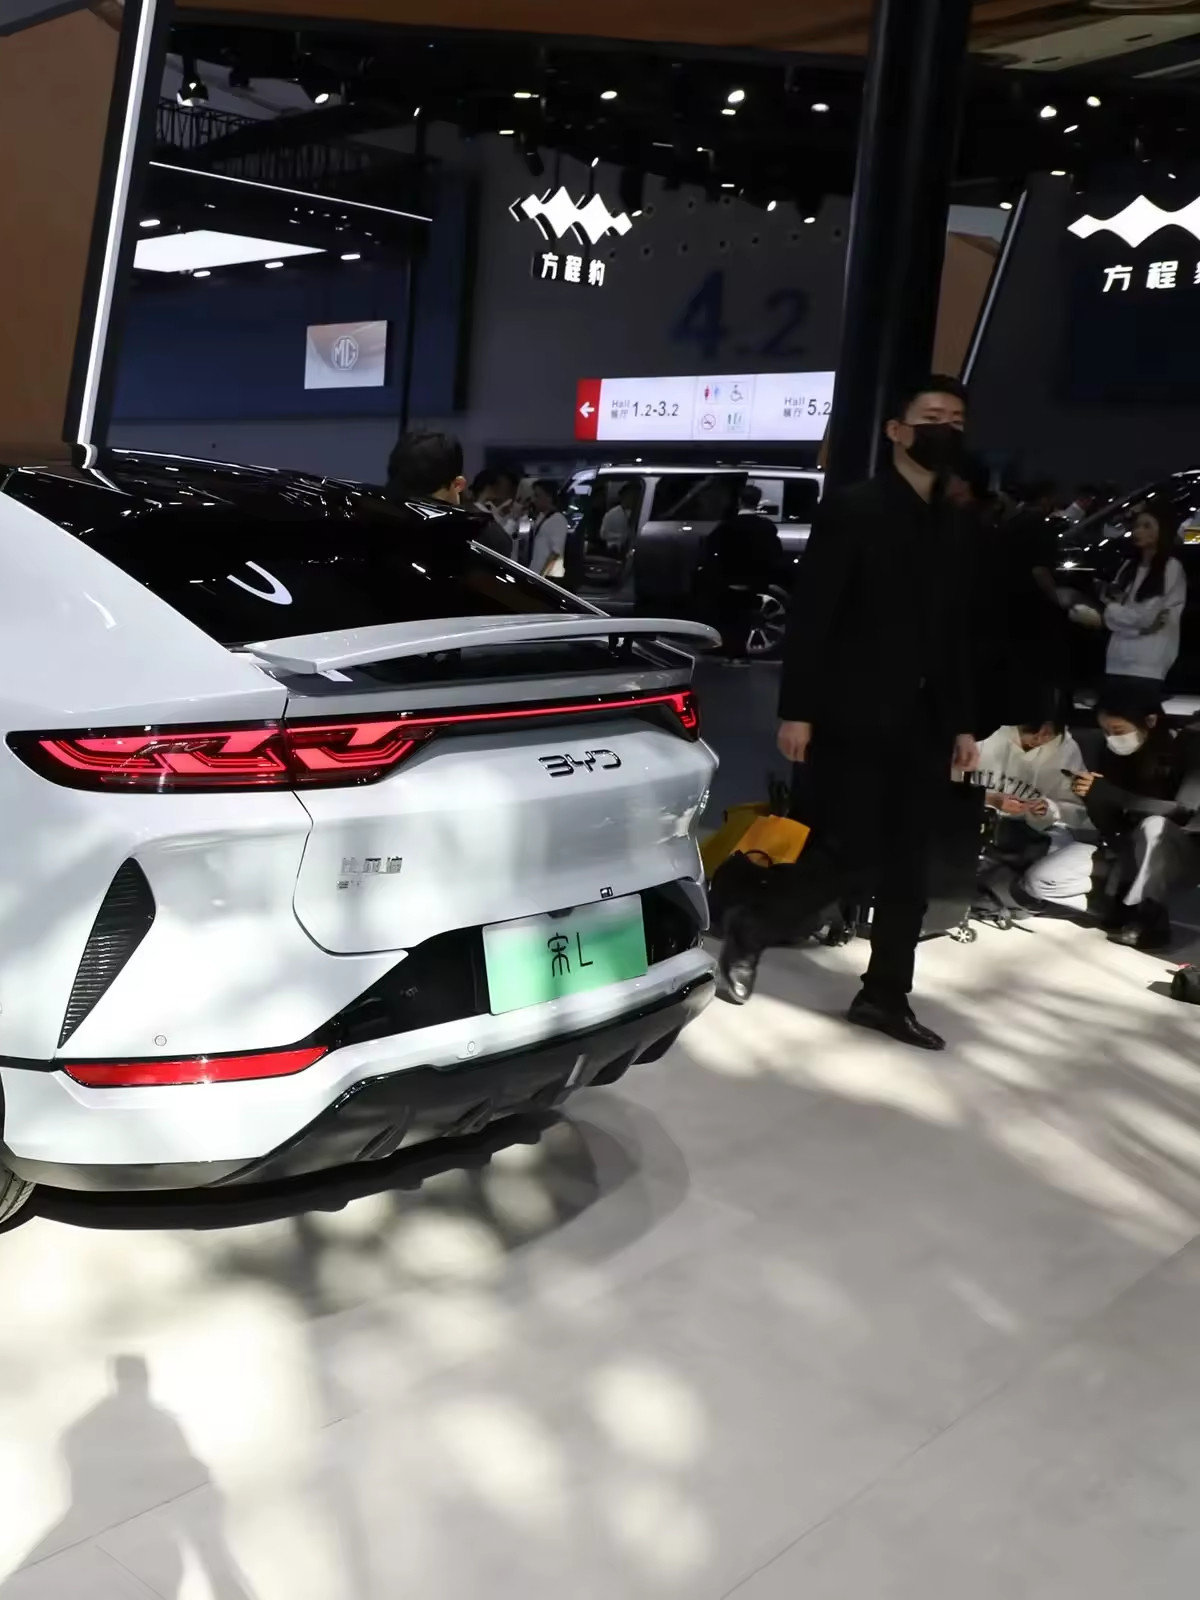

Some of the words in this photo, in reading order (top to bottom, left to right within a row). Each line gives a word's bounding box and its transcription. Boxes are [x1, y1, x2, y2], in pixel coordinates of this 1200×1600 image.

[541, 252, 606, 287] 方程豹
[668, 268, 810, 359] 4.2
[334, 338, 357, 368] MG
[612, 400, 630, 408] Hall
[632, 400, 680, 417] 1.2-3.2
[784, 396, 806, 406] Hall
[807, 398, 832, 416] 5.2
[538, 748, 623, 778] BYD
